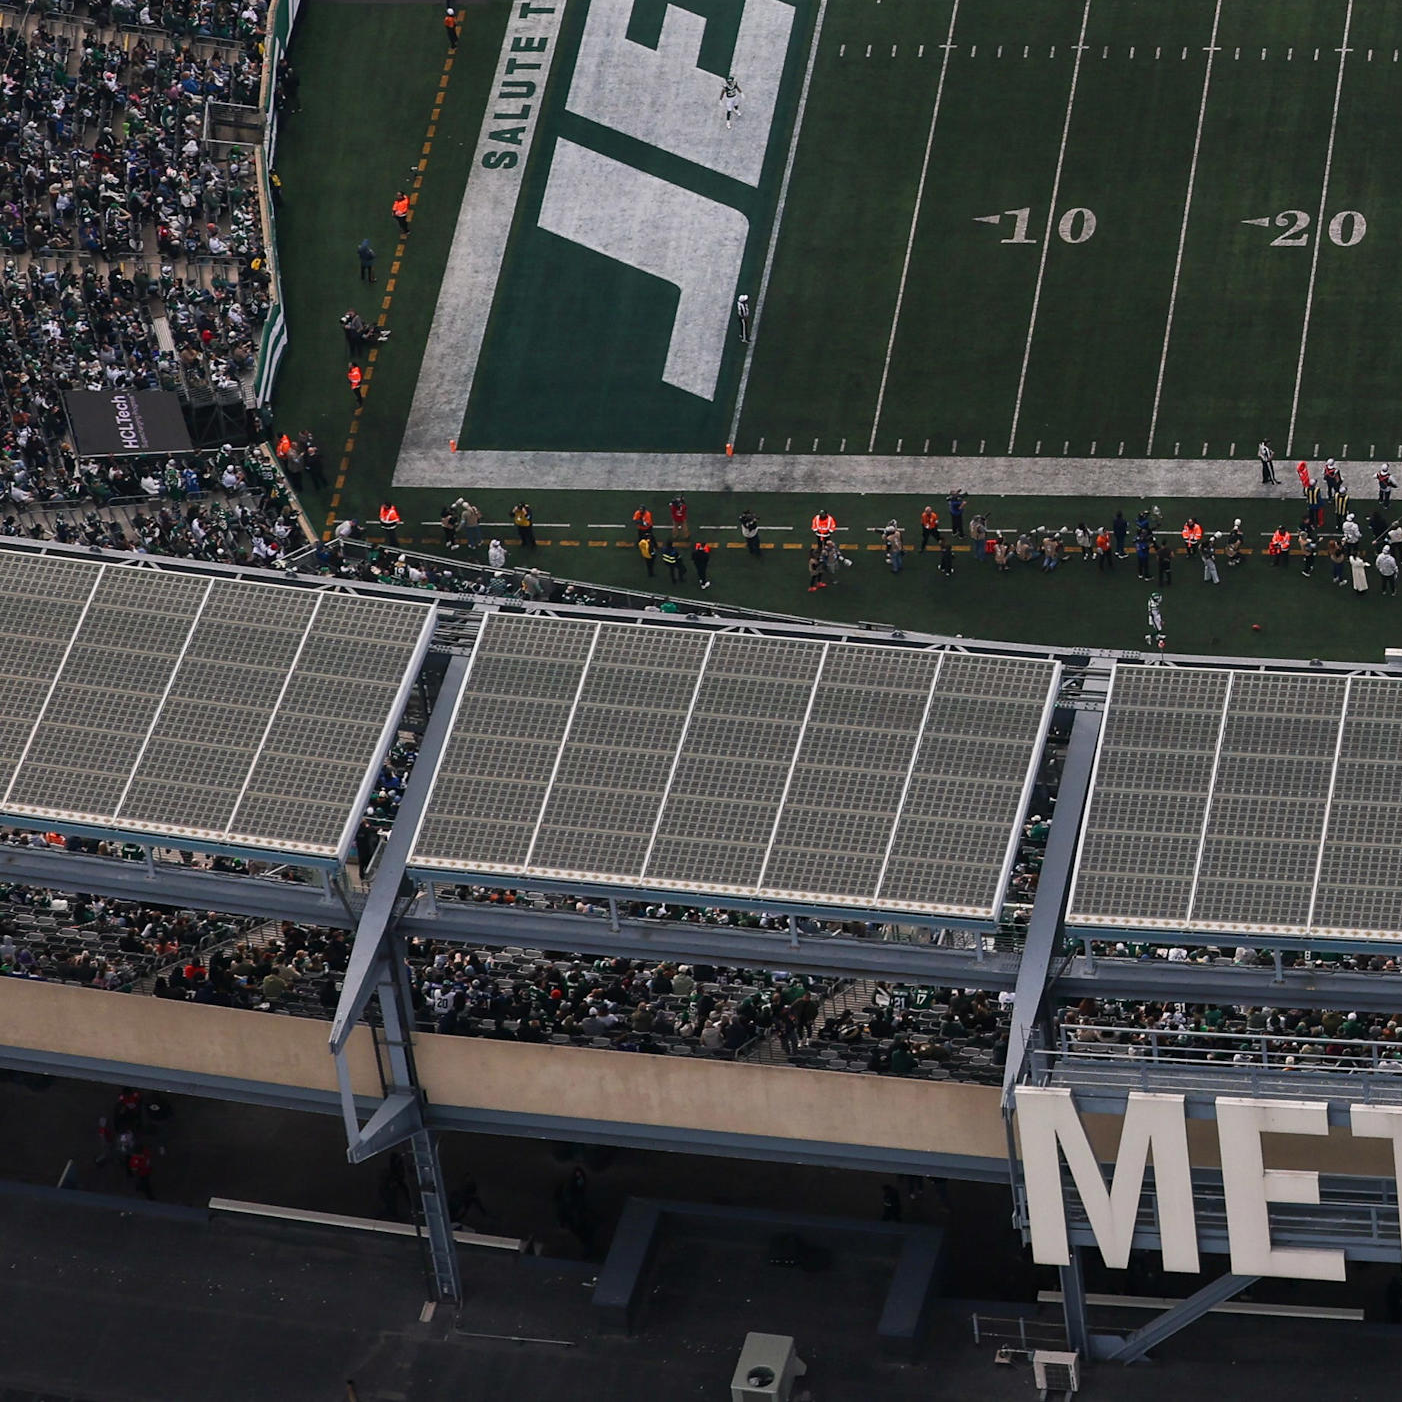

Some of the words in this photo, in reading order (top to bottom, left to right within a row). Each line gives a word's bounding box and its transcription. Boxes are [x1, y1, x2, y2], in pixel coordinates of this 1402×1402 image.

[481, 36, 549, 170] SALUTE
[1000, 208, 1097, 244] 10
[1269, 210, 1367, 247] 20
[111, 395, 140, 449] HCLTech
